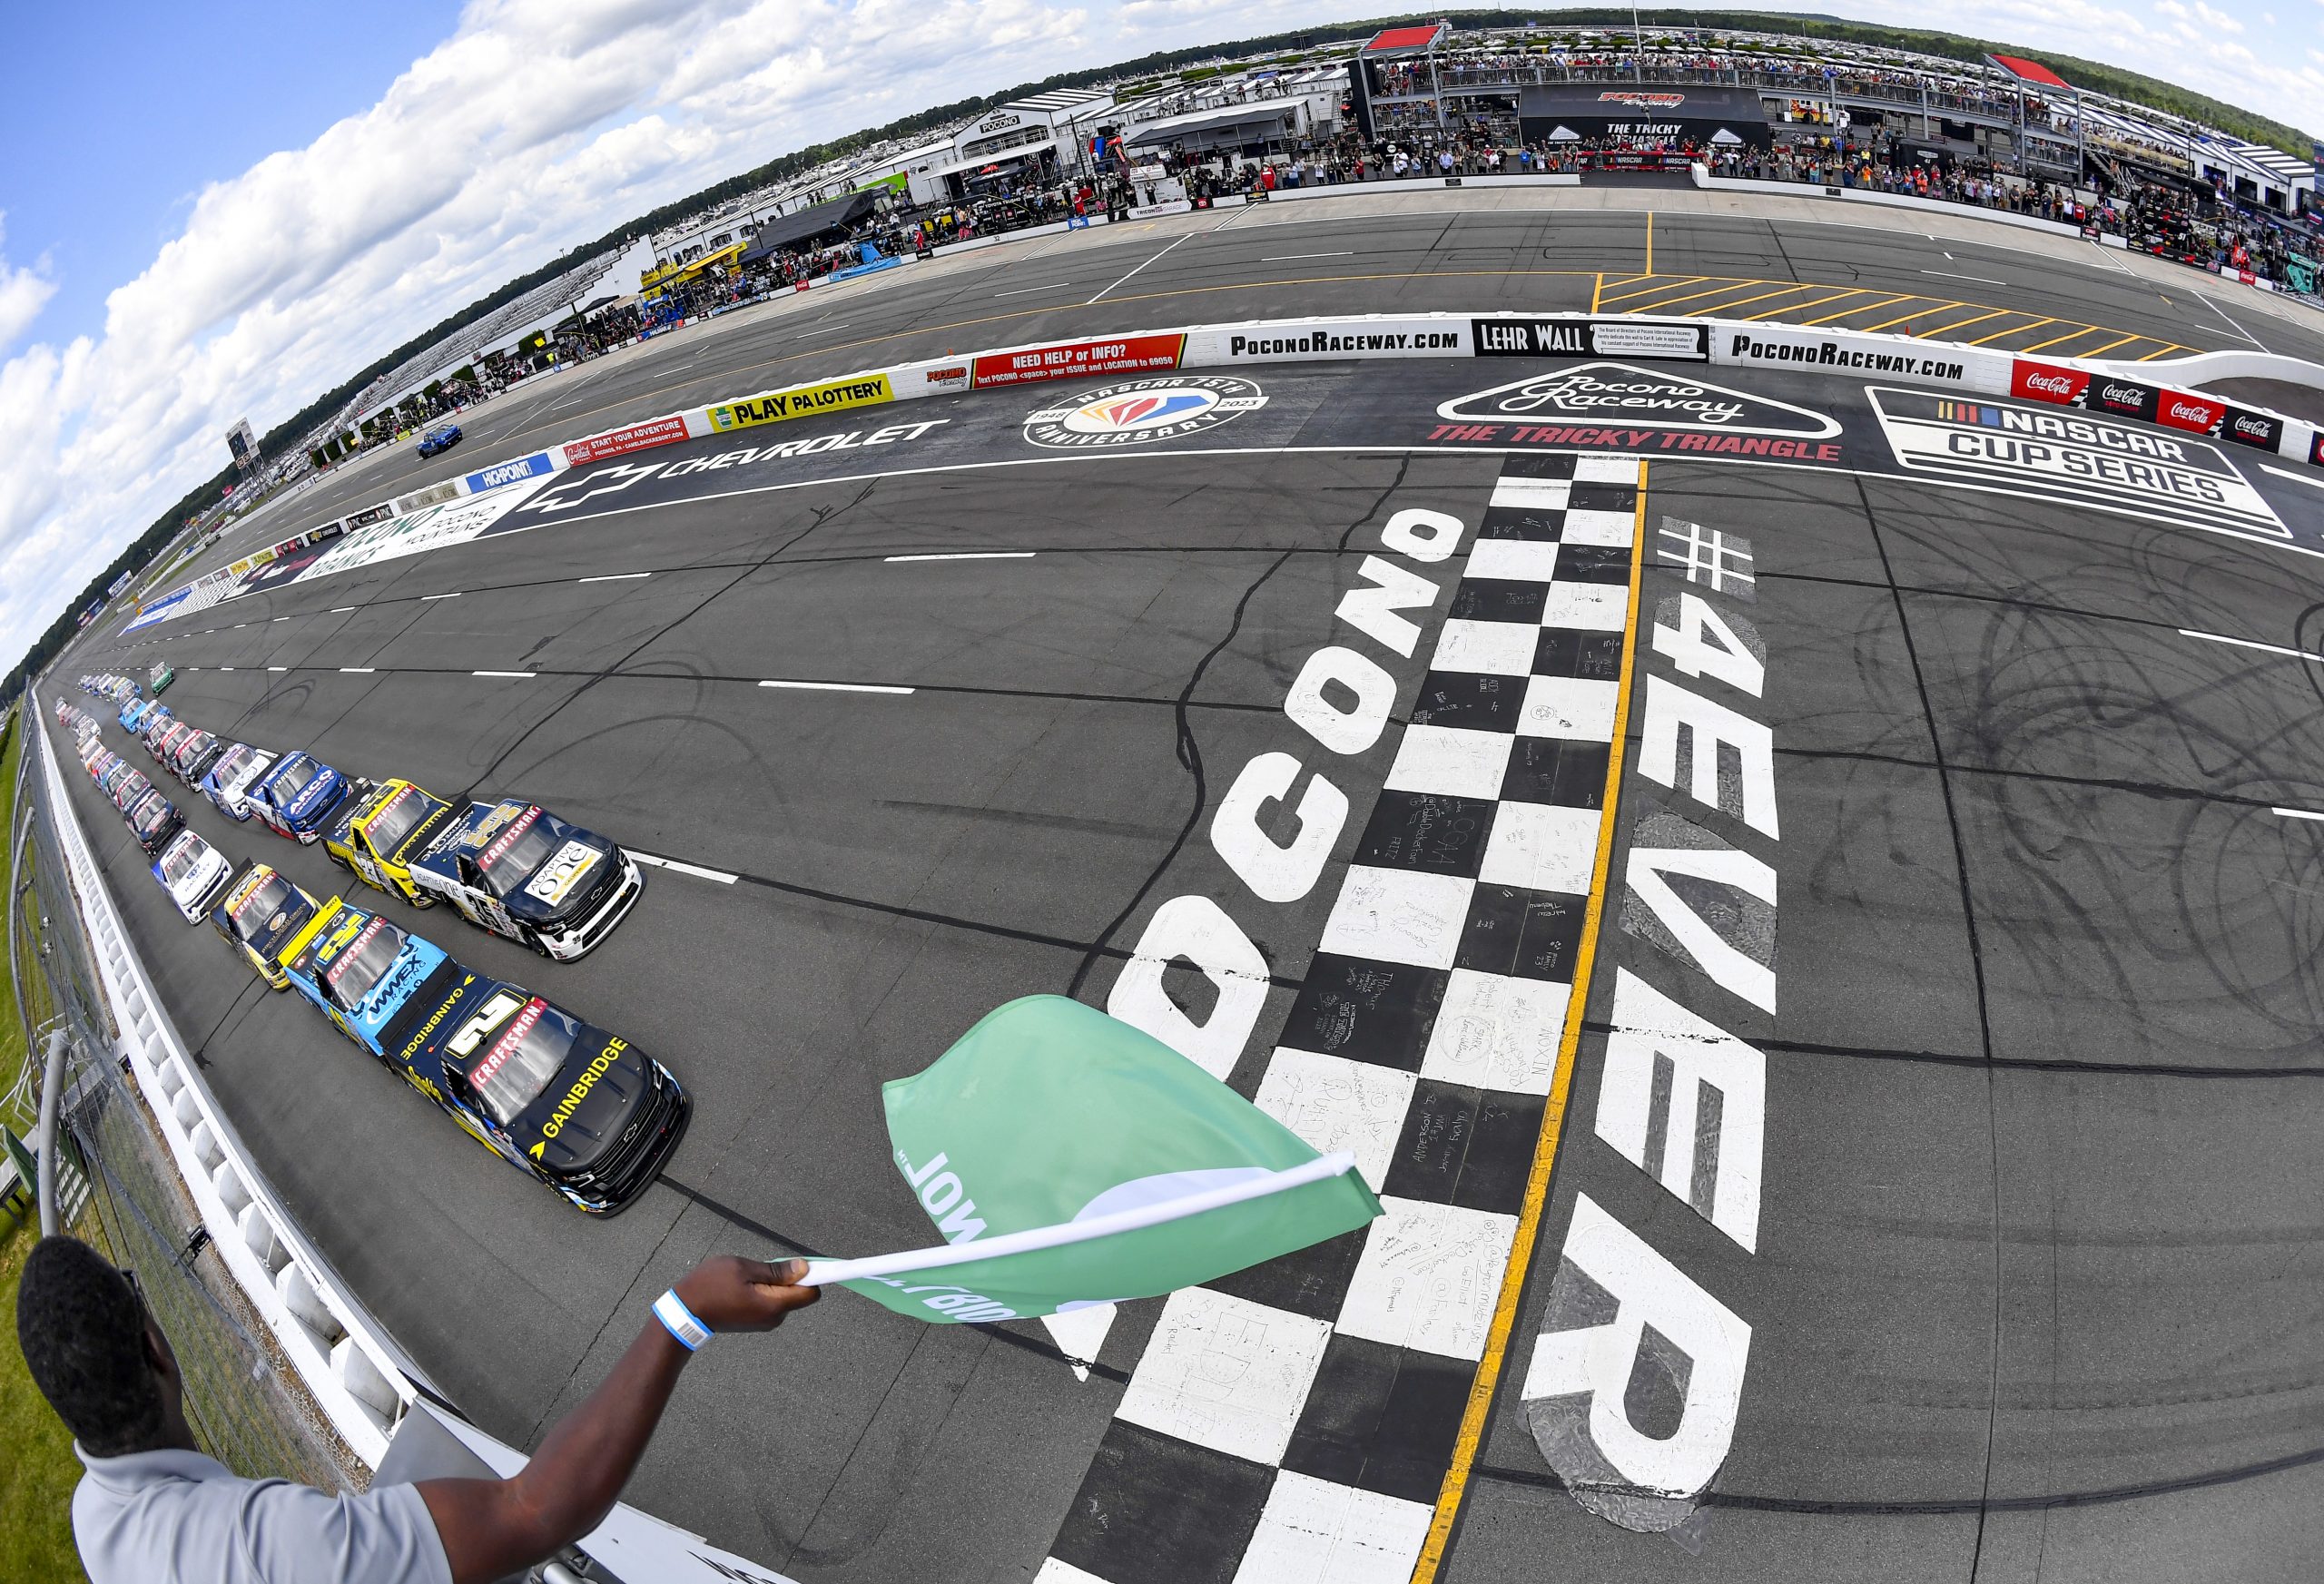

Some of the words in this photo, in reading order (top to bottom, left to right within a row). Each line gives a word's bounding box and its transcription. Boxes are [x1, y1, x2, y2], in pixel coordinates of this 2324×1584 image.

[982, 116, 1018, 133] POCONO
[1607, 123, 1631, 134] THE
[1635, 123, 1682, 135] TRICKY
[1617, 156, 1643, 164] NASCAR
[1665, 157, 1691, 165] NASCAR
[1481, 324, 1529, 350] LEHR
[1535, 324, 1585, 351] WALL
[977, 375, 990, 384] Text
[991, 370, 1018, 382] POCONO
[1019, 368, 1049, 379] <space>
[1049, 367, 1065, 377] your
[1067, 363, 1087, 374] ISSUE
[1088, 361, 1102, 372] and
[1103, 359, 1138, 369] LOCATION
[1139, 359, 1147, 368] to
[1148, 356, 1173, 366] 69050
[1012, 354, 1041, 369] NEED
[1044, 349, 1073, 365] HELP
[1076, 350, 1088, 361] or
[1091, 344, 1127, 359] INFO?
[927, 367, 967, 382] POCONO
[1077, 379, 1183, 404] NASCAR
[1189, 378, 1247, 394] 75TH
[1521, 375, 1704, 397] Pocono
[2026, 372, 2073, 395] Coca-Cola
[734, 396, 787, 424] PLAY
[792, 394, 813, 411] PA
[816, 379, 882, 406] LOTTERY
[1499, 389, 1744, 423] Raceway
[2102, 384, 2146, 407] Coca-Cola
[2171, 401, 2211, 424] Coca-Cola
[2234, 416, 2271, 438] Coca-Cola
[590, 437, 613, 449] START
[613, 431, 633, 442] YOUR
[634, 420, 681, 438] ADVENTURE
[1035, 413, 1219, 446] ANNIVERSARY
[1427, 425, 1505, 440] THE
[1511, 426, 1656, 447] TRICKY
[1660, 431, 1843, 462] TRIANGLE
[2002, 409, 2189, 463] NASCAR
[657, 418, 952, 479] CHEVROLET
[482, 460, 528, 487] HIGHPOINT
[1948, 433, 2051, 465] CUP
[2061, 450, 2225, 502] SERIES
[273, 755, 307, 789] CRAFTSMAN
[290, 769, 332, 815] ARCO
[368, 786, 412, 833] CRAFTSMAN
[484, 809, 537, 865] CRAFTSMAN
[1384, 837, 1402, 860] FRITZ
[166, 837, 195, 871] CRAFTSMAN
[531, 843, 576, 891] ADAPTIVE
[235, 873, 274, 918] CRAFTSMAN
[331, 921, 382, 979] CRAFTSMAN
[1040, 508, 1466, 1384] OCONO
[1535, 956, 1543, 966] 23
[391, 961, 427, 1001] RACING
[1526, 515, 1778, 1500] #4EVER
[400, 988, 465, 1061] GAINBRIDGE
[1469, 1028, 1484, 1051] SPARK
[475, 1003, 542, 1086] CRAFTSMAN
[542, 1036, 628, 1139] GAINBRIDGE
[1413, 1112, 1432, 1163] ANDERSON
[1161, 1328, 1178, 1355] Rachel
